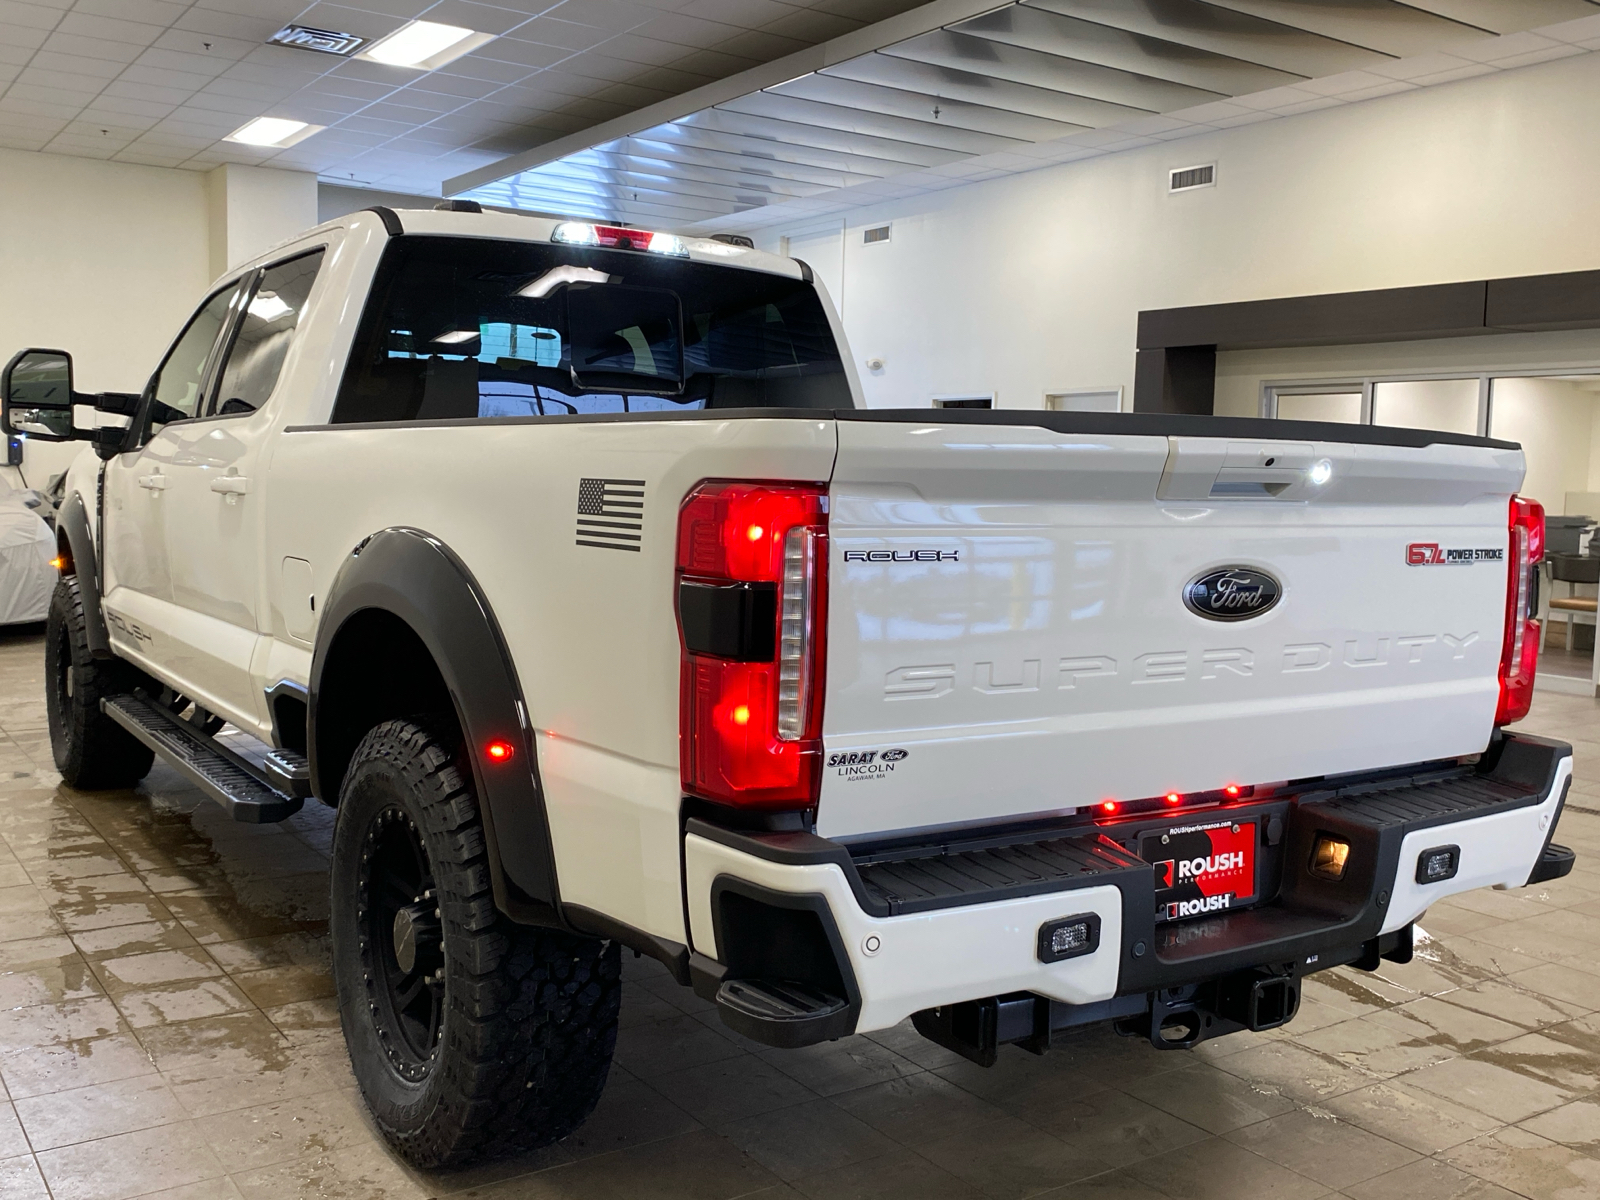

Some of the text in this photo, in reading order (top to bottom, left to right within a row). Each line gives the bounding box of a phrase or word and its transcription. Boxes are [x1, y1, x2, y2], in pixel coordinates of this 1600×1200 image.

[844, 550, 959, 562] ROUSH
[1446, 549, 1474, 560] POWER
[1474, 548, 1503, 560] STROKE
[1210, 577, 1264, 609] Ford
[884, 631, 1480, 702] SUPER DUTY
[827, 750, 878, 768] SARAT
[838, 763, 895, 776] LINCOLN
[1169, 821, 1232, 835] ROUSHperformance.com
[1178, 851, 1244, 878] ROUSH
[1178, 869, 1243, 885] PERFORMANCE
[1179, 894, 1231, 916] ROUSH
